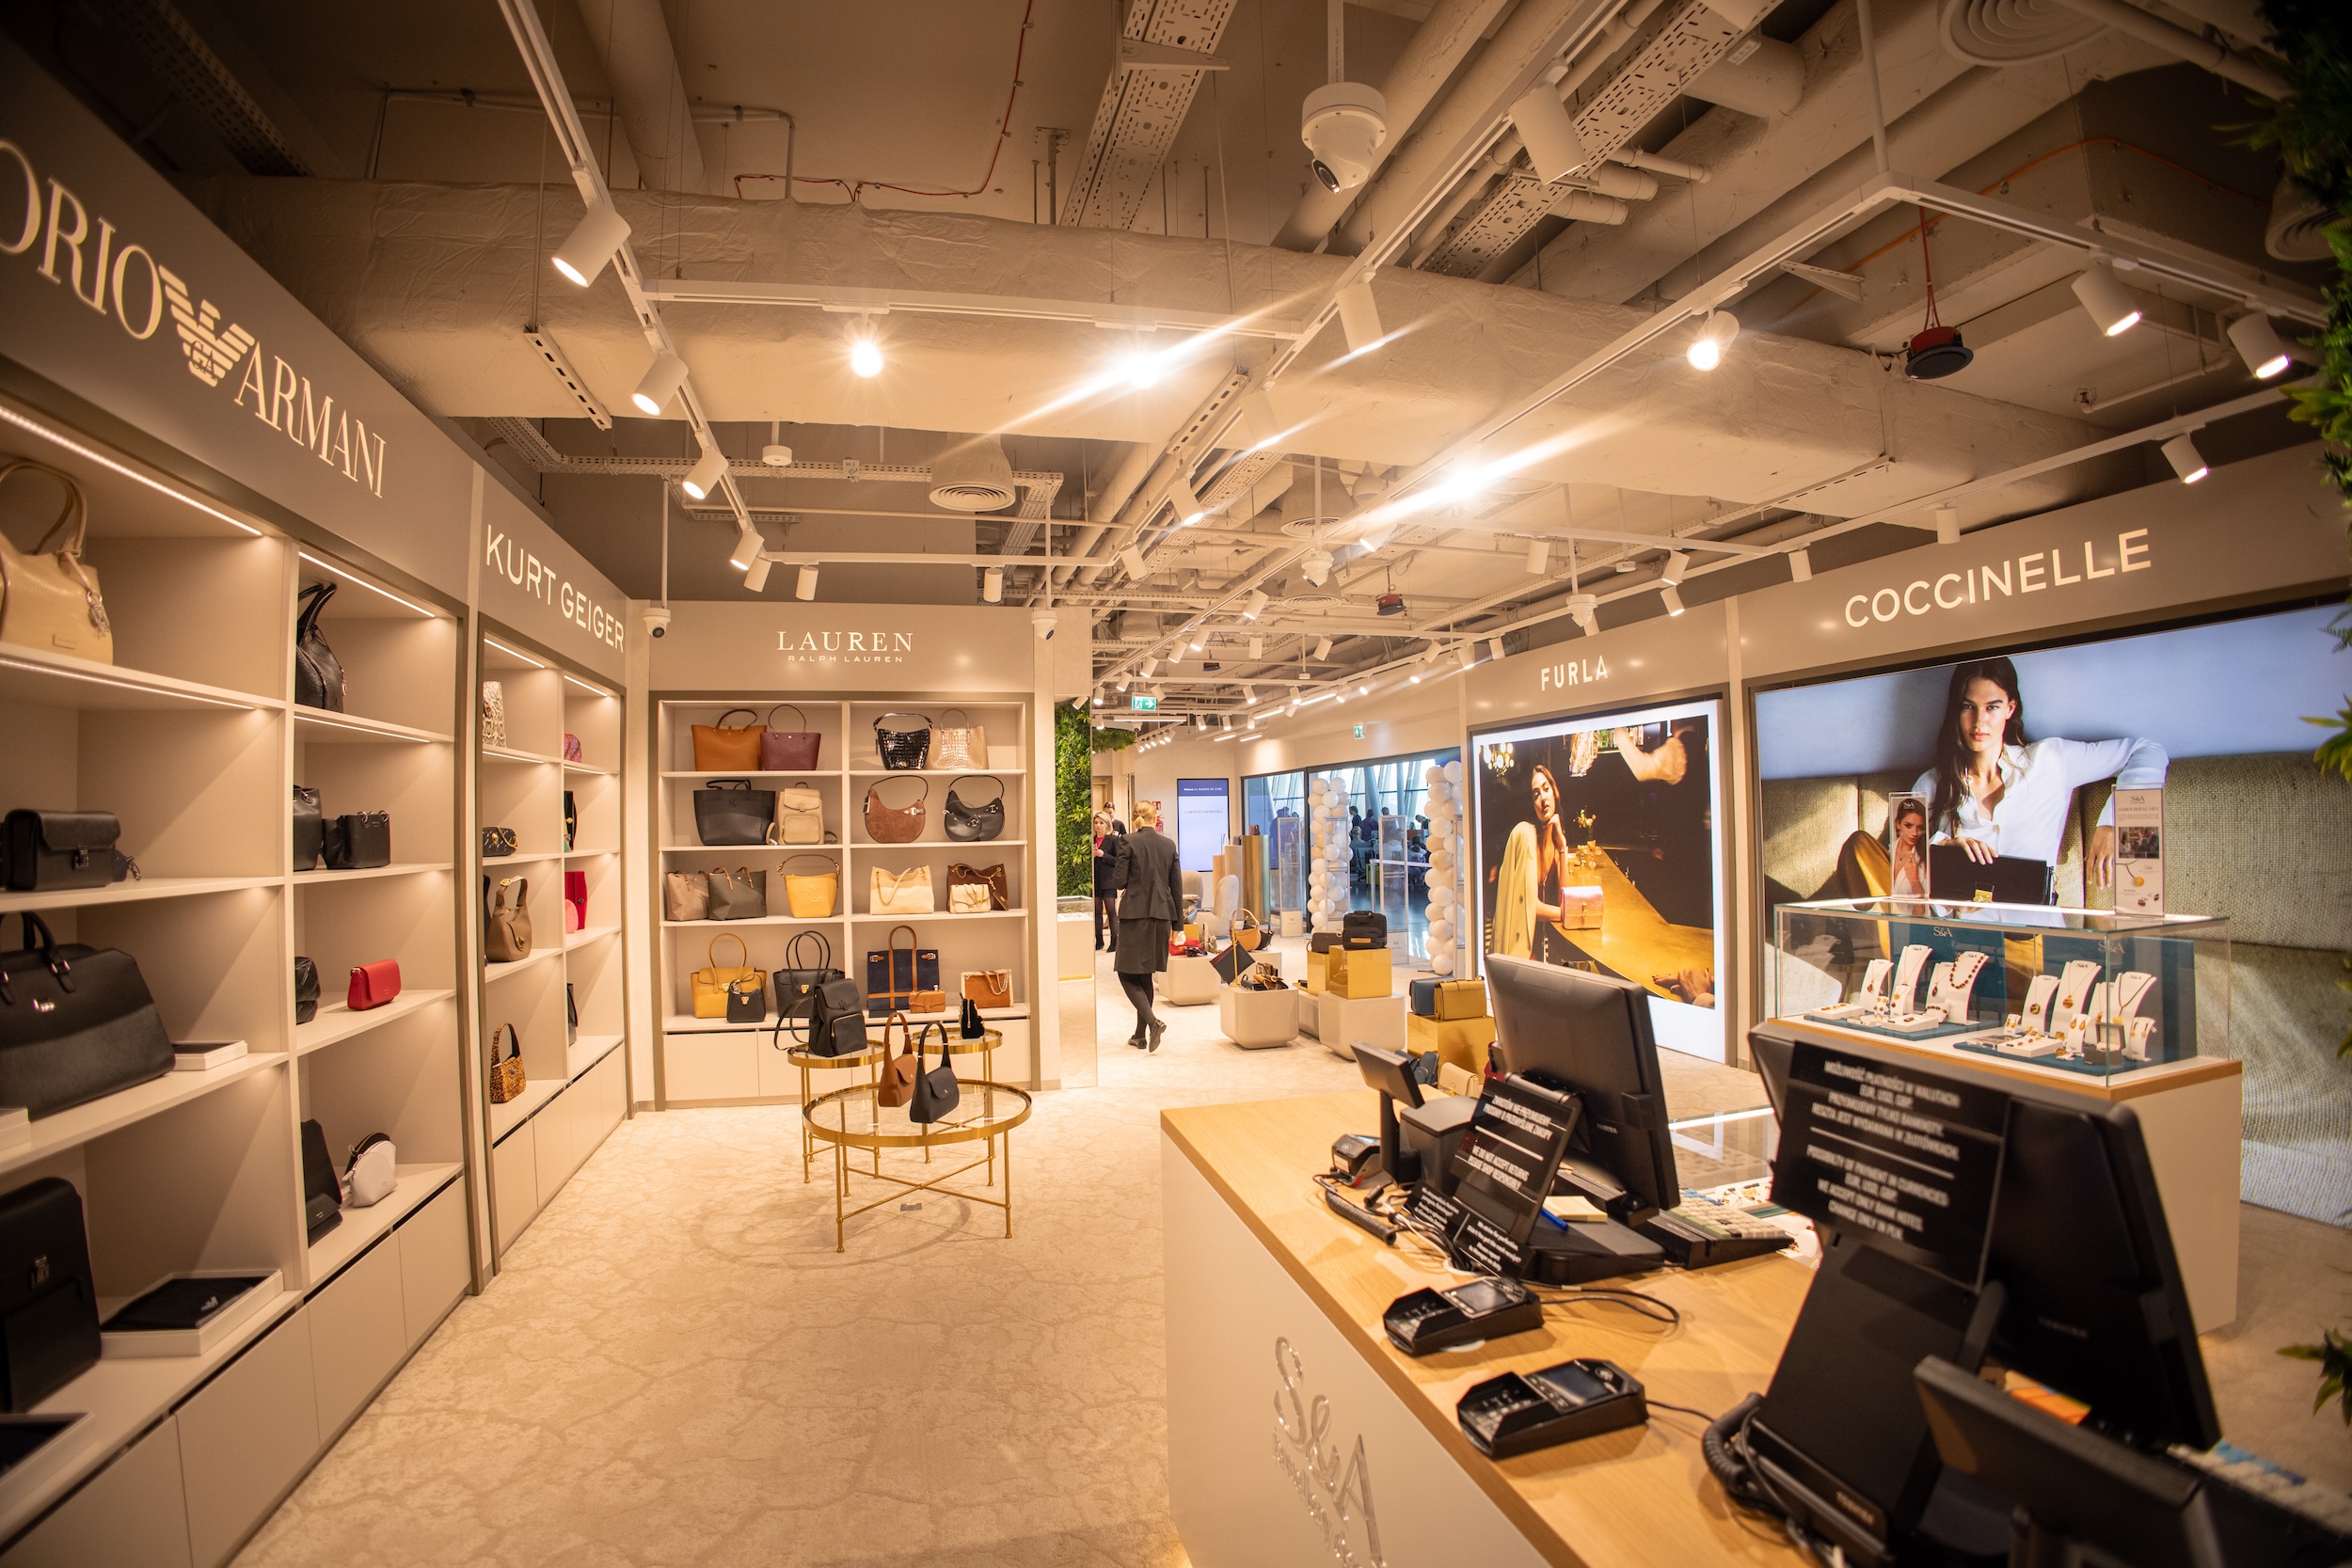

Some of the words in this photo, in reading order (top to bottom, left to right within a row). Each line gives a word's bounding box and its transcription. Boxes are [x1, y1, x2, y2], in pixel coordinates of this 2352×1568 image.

[234, 339, 387, 499] ARMANI
[485, 523, 557, 606] KURT
[561, 581, 625, 654] GEIGER
[1844, 527, 2153, 627] COCCINELLE
[776, 630, 914, 652] LAUREN
[1540, 654, 1609, 692] FURLA
[1933, 927, 1953, 938] S&A
